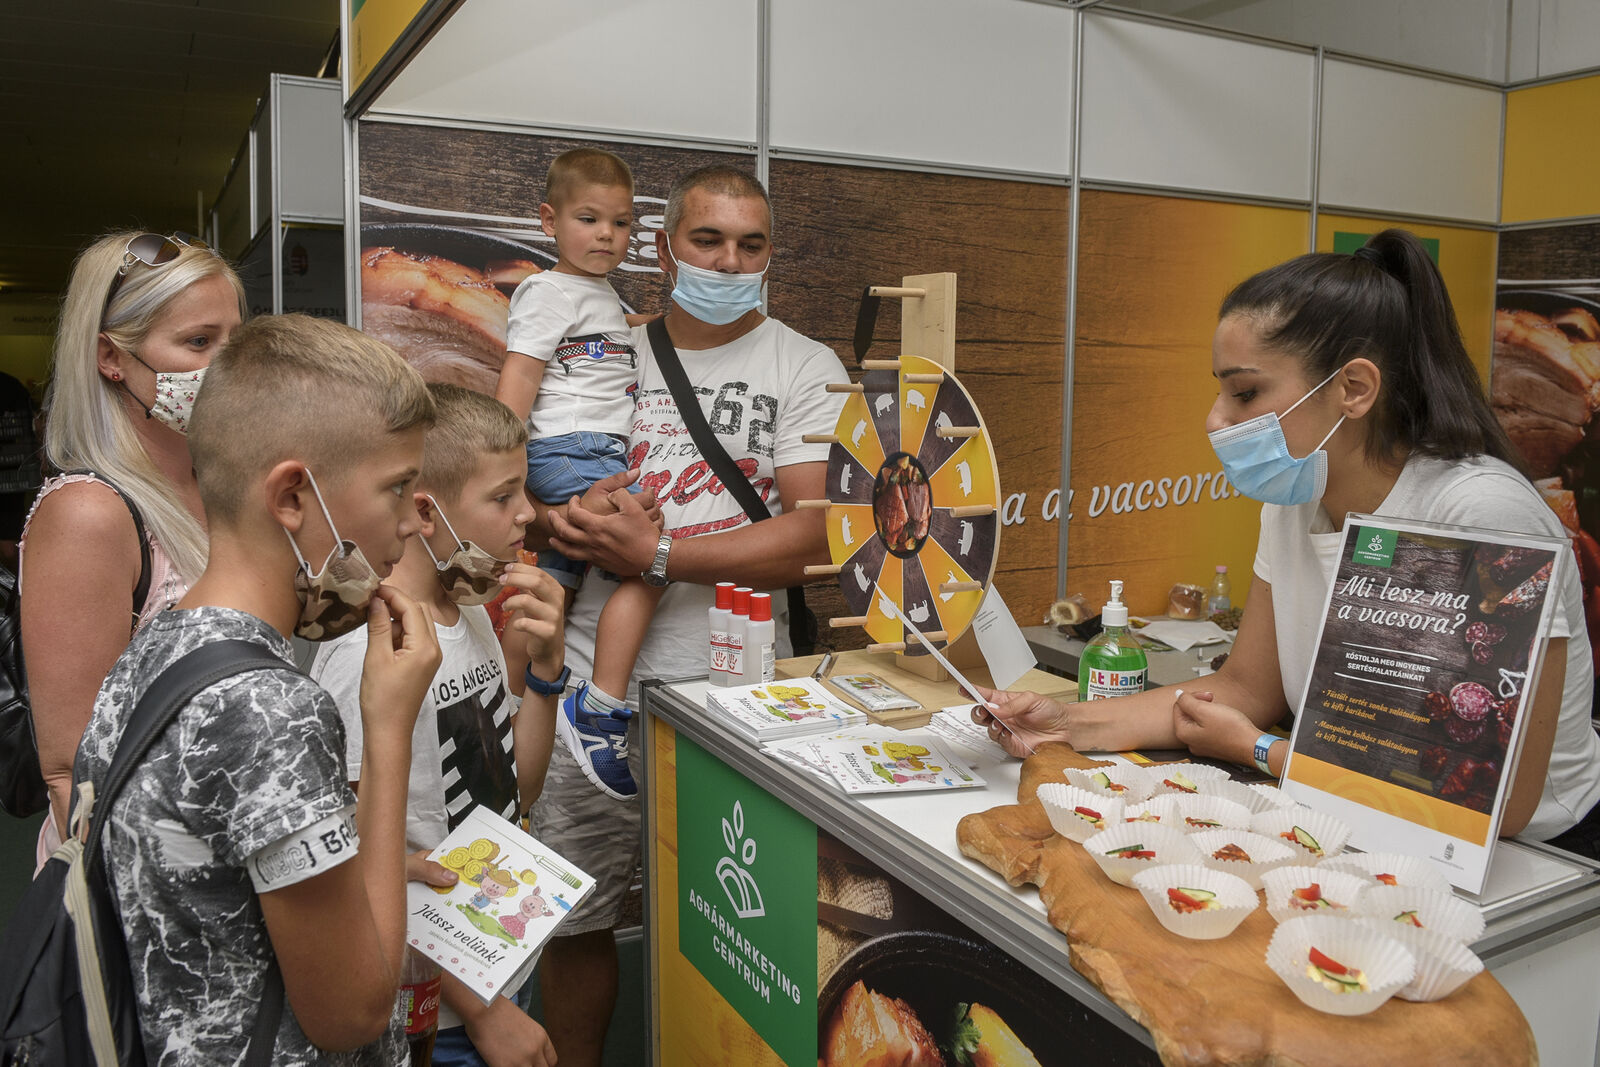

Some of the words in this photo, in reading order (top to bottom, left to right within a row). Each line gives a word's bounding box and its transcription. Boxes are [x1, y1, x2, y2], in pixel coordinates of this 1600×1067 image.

[709, 381, 778, 458] 62
[1088, 470, 1240, 518] vacsora
[1339, 575, 1376, 598] Mi
[1379, 576, 1424, 604] lesz
[1430, 591, 1470, 610] ma
[1337, 604, 1353, 620] a
[1358, 607, 1467, 635] vacsora?
[1091, 671, 1105, 685] At
[1110, 671, 1143, 686] Hand
[1345, 652, 1380, 664] KÓSTOLJA
[1379, 658, 1395, 667] MEG
[1395, 661, 1431, 673] INGYENES
[432, 678, 460, 705] LOS
[410, 903, 455, 932] Játssz
[453, 930, 505, 965] velünk!
[689, 888, 801, 1005] AGRÁRMARKETING
[713, 935, 770, 1004] CENTRUM
